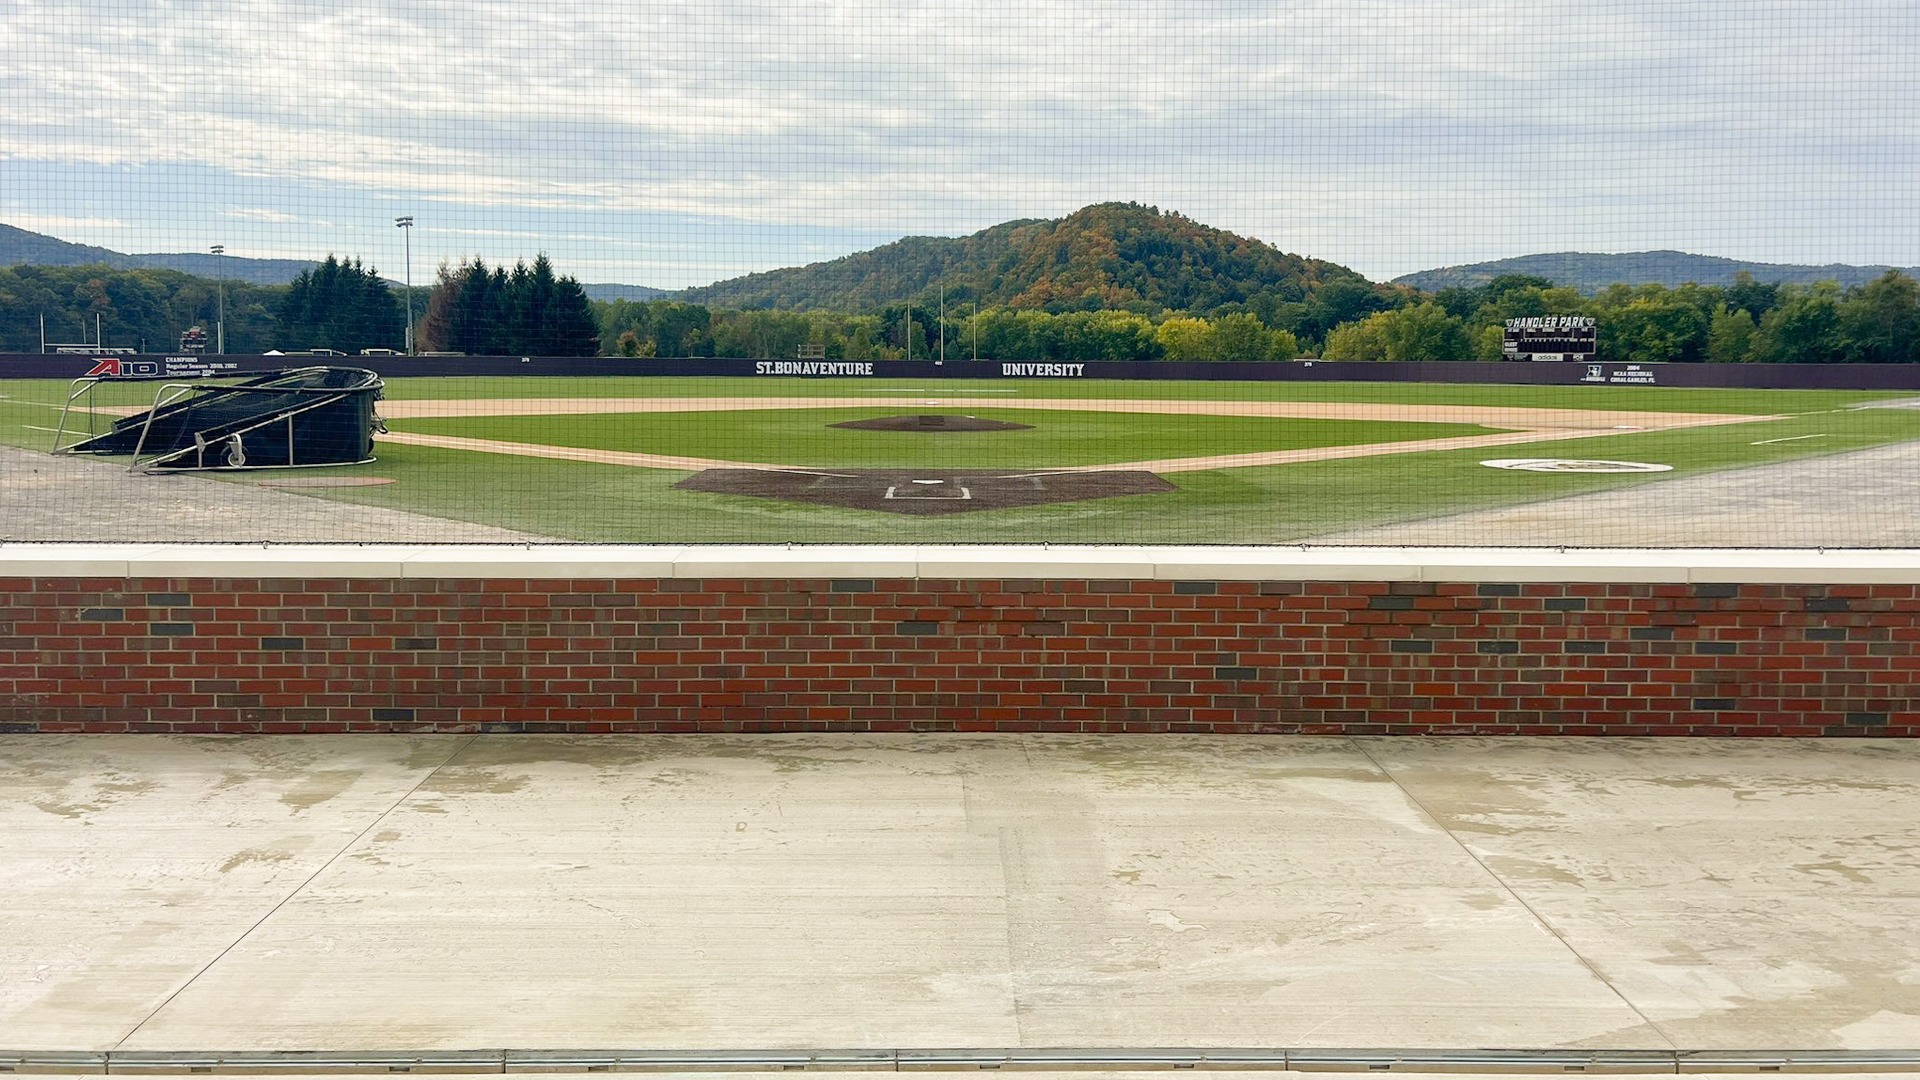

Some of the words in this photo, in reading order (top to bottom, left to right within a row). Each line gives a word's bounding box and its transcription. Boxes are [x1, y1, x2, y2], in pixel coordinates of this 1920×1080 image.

[1513, 317, 1558, 327] HANDLER
[1559, 316, 1586, 327] PARK
[1001, 363, 1085, 377] UNIVERSITY
